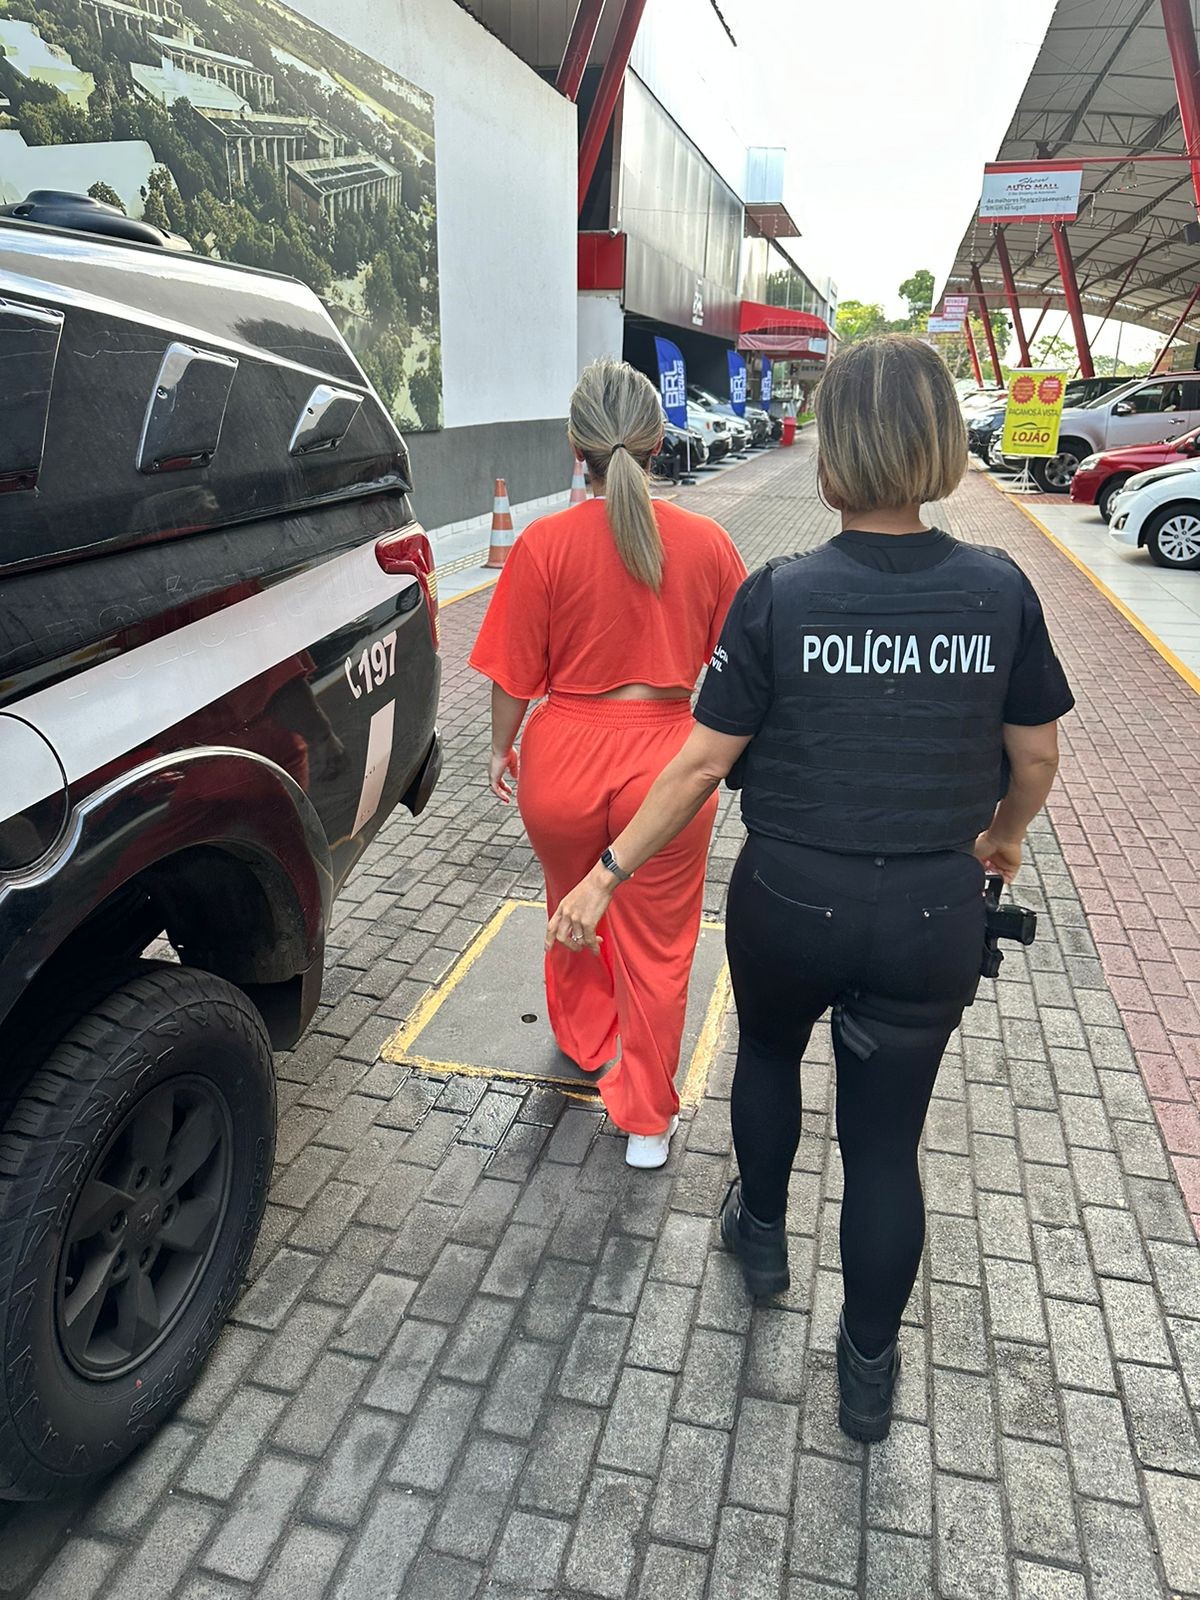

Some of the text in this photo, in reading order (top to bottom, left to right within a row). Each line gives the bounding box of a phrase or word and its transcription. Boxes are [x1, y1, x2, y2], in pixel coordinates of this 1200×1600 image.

[665, 360, 679, 408] BRL
[732, 368, 743, 404] BRL
[1012, 430, 1051, 443] LOJÃO
[358, 630, 398, 694] 197
[803, 629, 996, 674] POLÍCIA CIVIL
